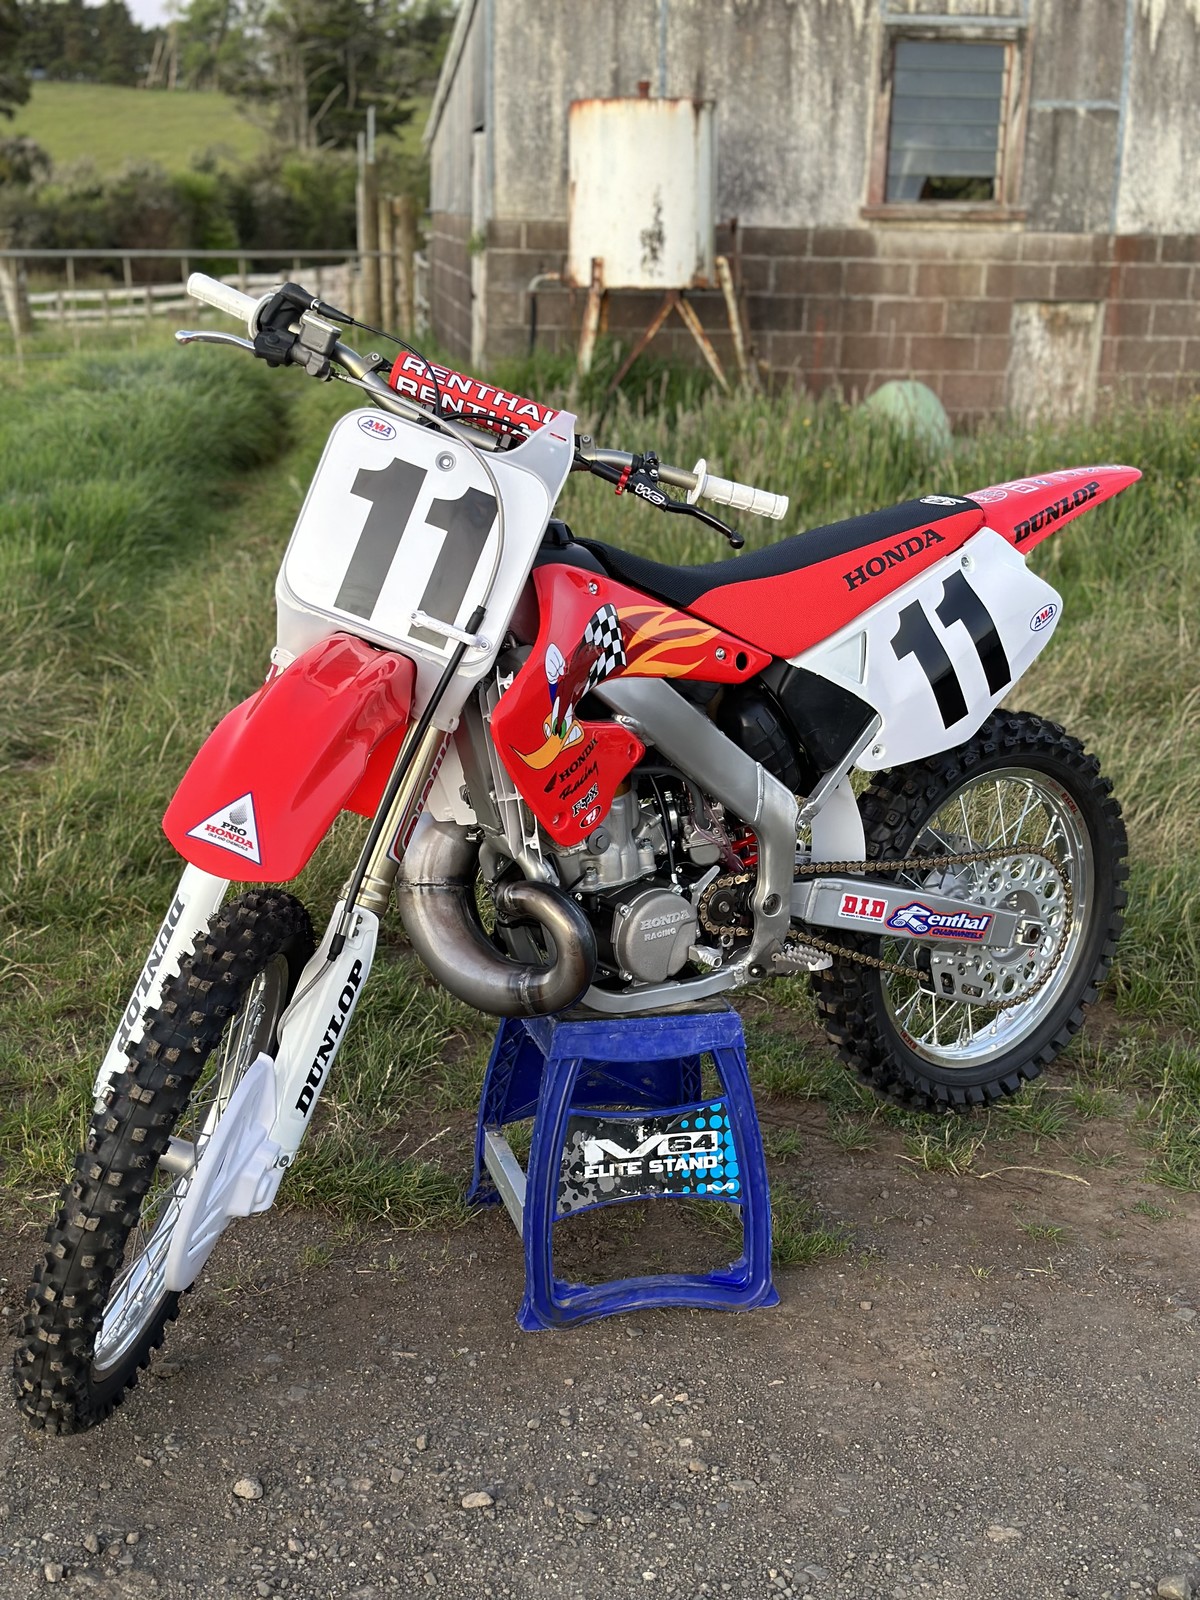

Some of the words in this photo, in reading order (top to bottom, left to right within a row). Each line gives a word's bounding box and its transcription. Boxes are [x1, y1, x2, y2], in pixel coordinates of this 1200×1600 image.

[402, 356, 554, 425] RENTHAL
[396, 375, 530, 441] RENTHA
[362, 419, 392, 435] AMA
[1013, 481, 1100, 544] DUNLOP
[334, 457, 499, 650] 11
[842, 529, 945, 591] HONDA
[1034, 606, 1054, 626] AMA
[890, 569, 1012, 730] 11
[559, 761, 599, 800] Racing
[1061, 792, 1078, 815] EXCEL
[204, 824, 254, 849] HONDA
[221, 821, 247, 836] PRO
[640, 910, 690, 931] HONDA
[644, 927, 677, 941] RACING
[891, 905, 989, 932] Renthal
[117, 894, 185, 1053] DUNLOP
[295, 959, 362, 1118] DUNLOP
[584, 1162, 642, 1179] ELITE
[649, 1155, 719, 1173] STAND
